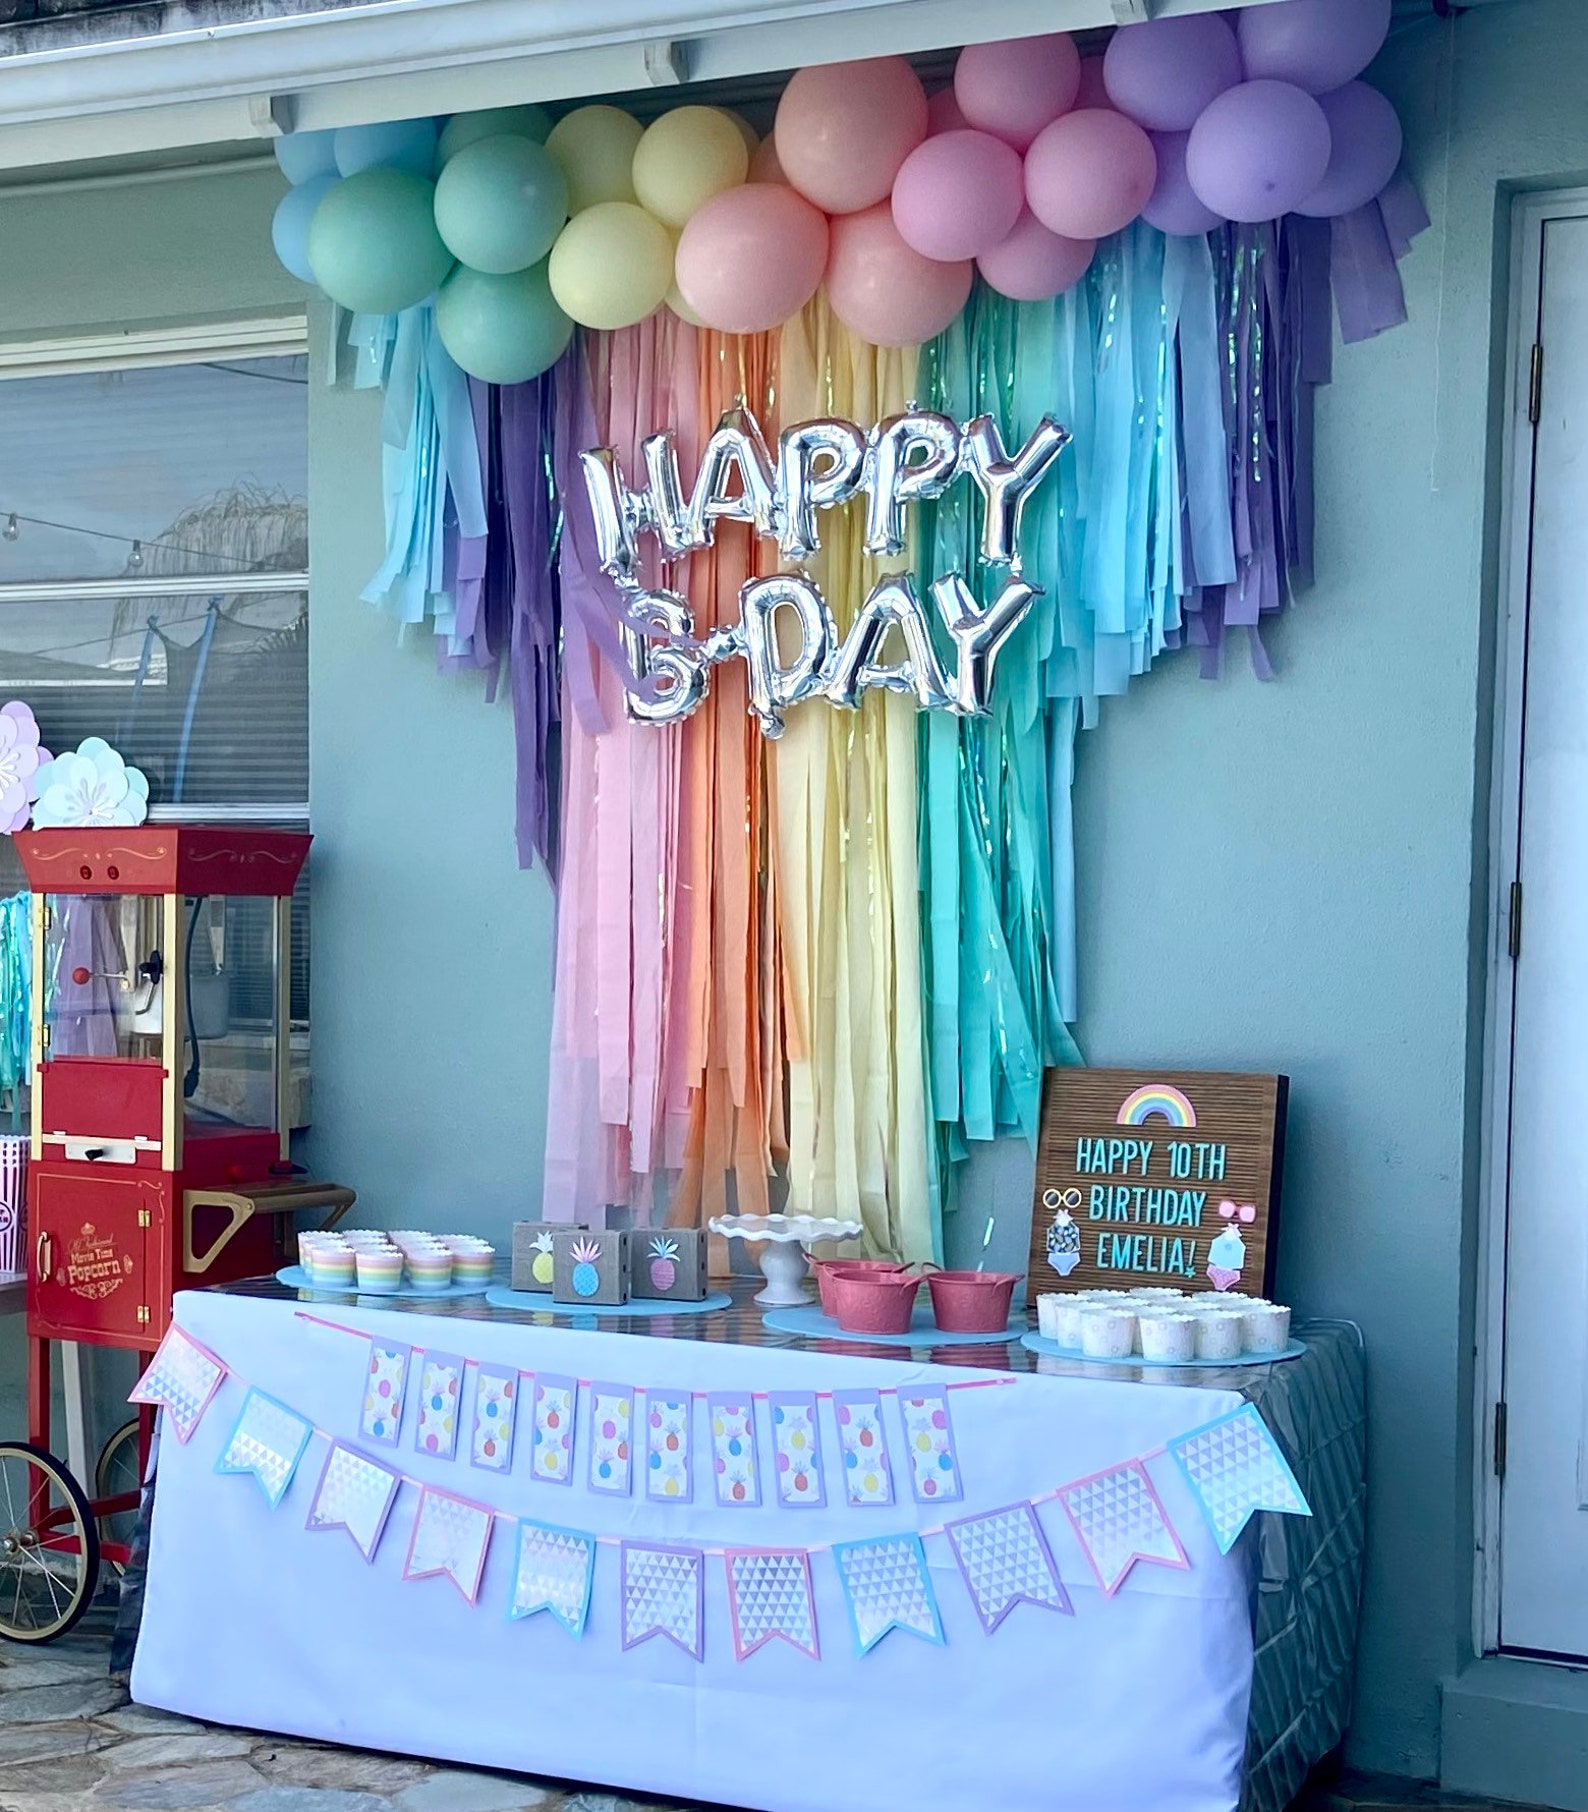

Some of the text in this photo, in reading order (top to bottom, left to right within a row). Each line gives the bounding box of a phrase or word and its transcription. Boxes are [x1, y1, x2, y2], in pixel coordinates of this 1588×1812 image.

[579, 400, 1073, 567] HAPPY
[622, 569, 1046, 739] B-DAY
[1075, 1137, 1227, 1180] HAPPY 10TH
[1089, 1184, 1206, 1227] BIRTHDAY
[67, 1260, 121, 1285] Popcorn
[1096, 1233, 1196, 1278] EMELIA!
